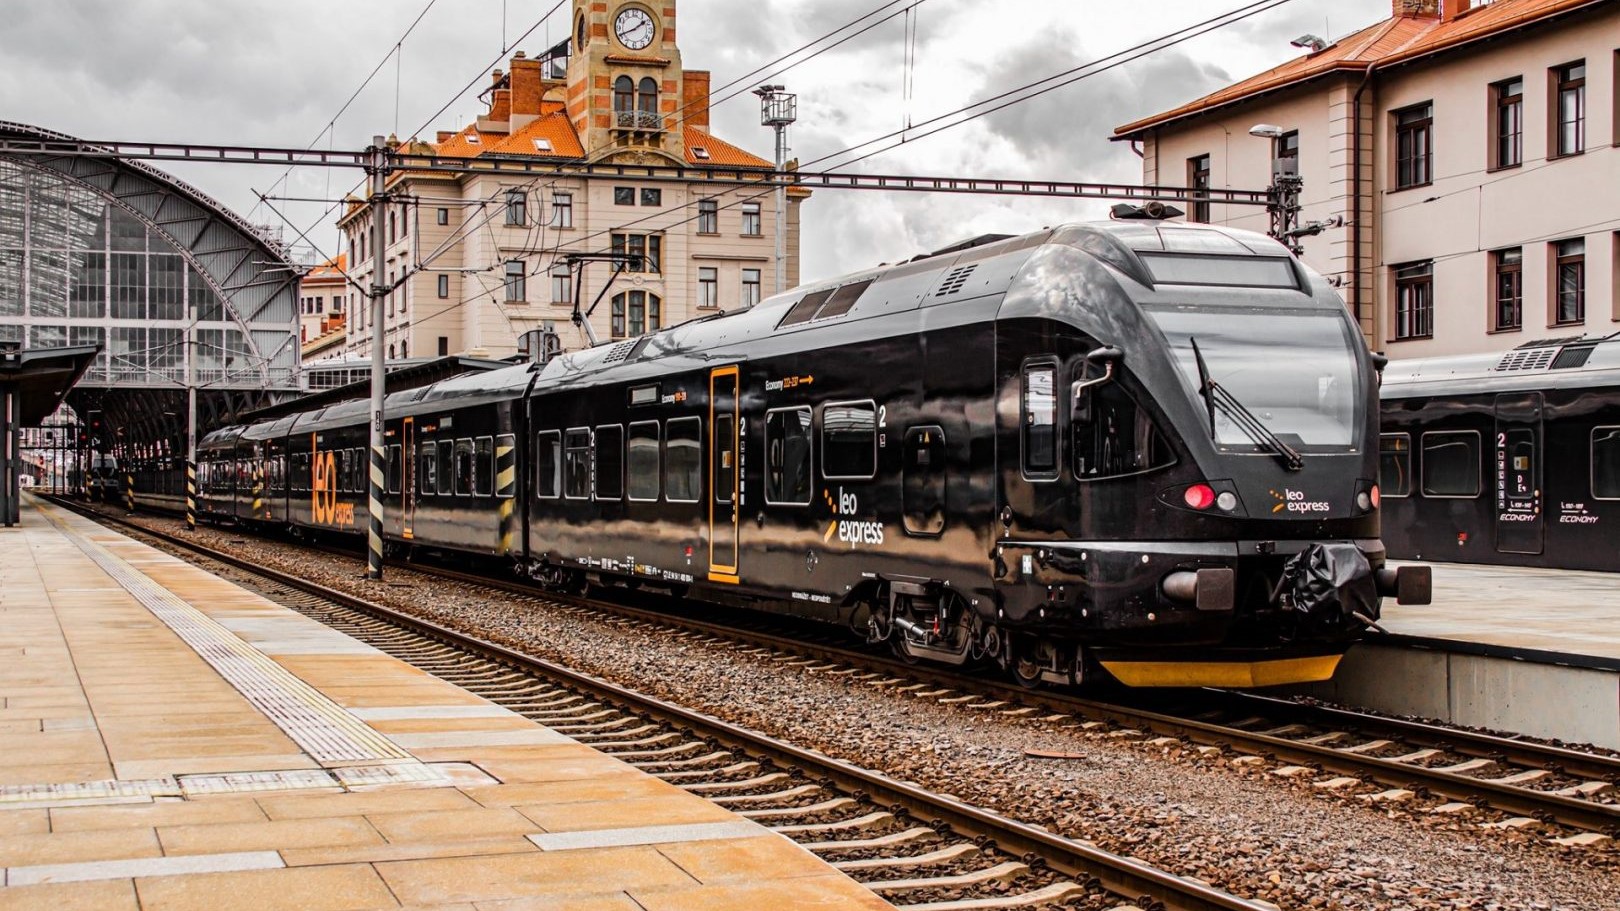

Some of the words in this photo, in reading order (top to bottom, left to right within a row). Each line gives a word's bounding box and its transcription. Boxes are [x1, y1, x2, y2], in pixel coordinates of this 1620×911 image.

[879, 404, 887, 428] 2
[740, 417, 746, 436] 2
[1497, 433, 1506, 448] 2
[311, 431, 337, 525] leo
[839, 486, 858, 515] leo
[1285, 488, 1304, 501] leo
[1287, 502, 1330, 514] express
[1500, 513, 1536, 522] ECONOMY
[1559, 515, 1599, 524] ECONOMY
[839, 520, 884, 549] express
